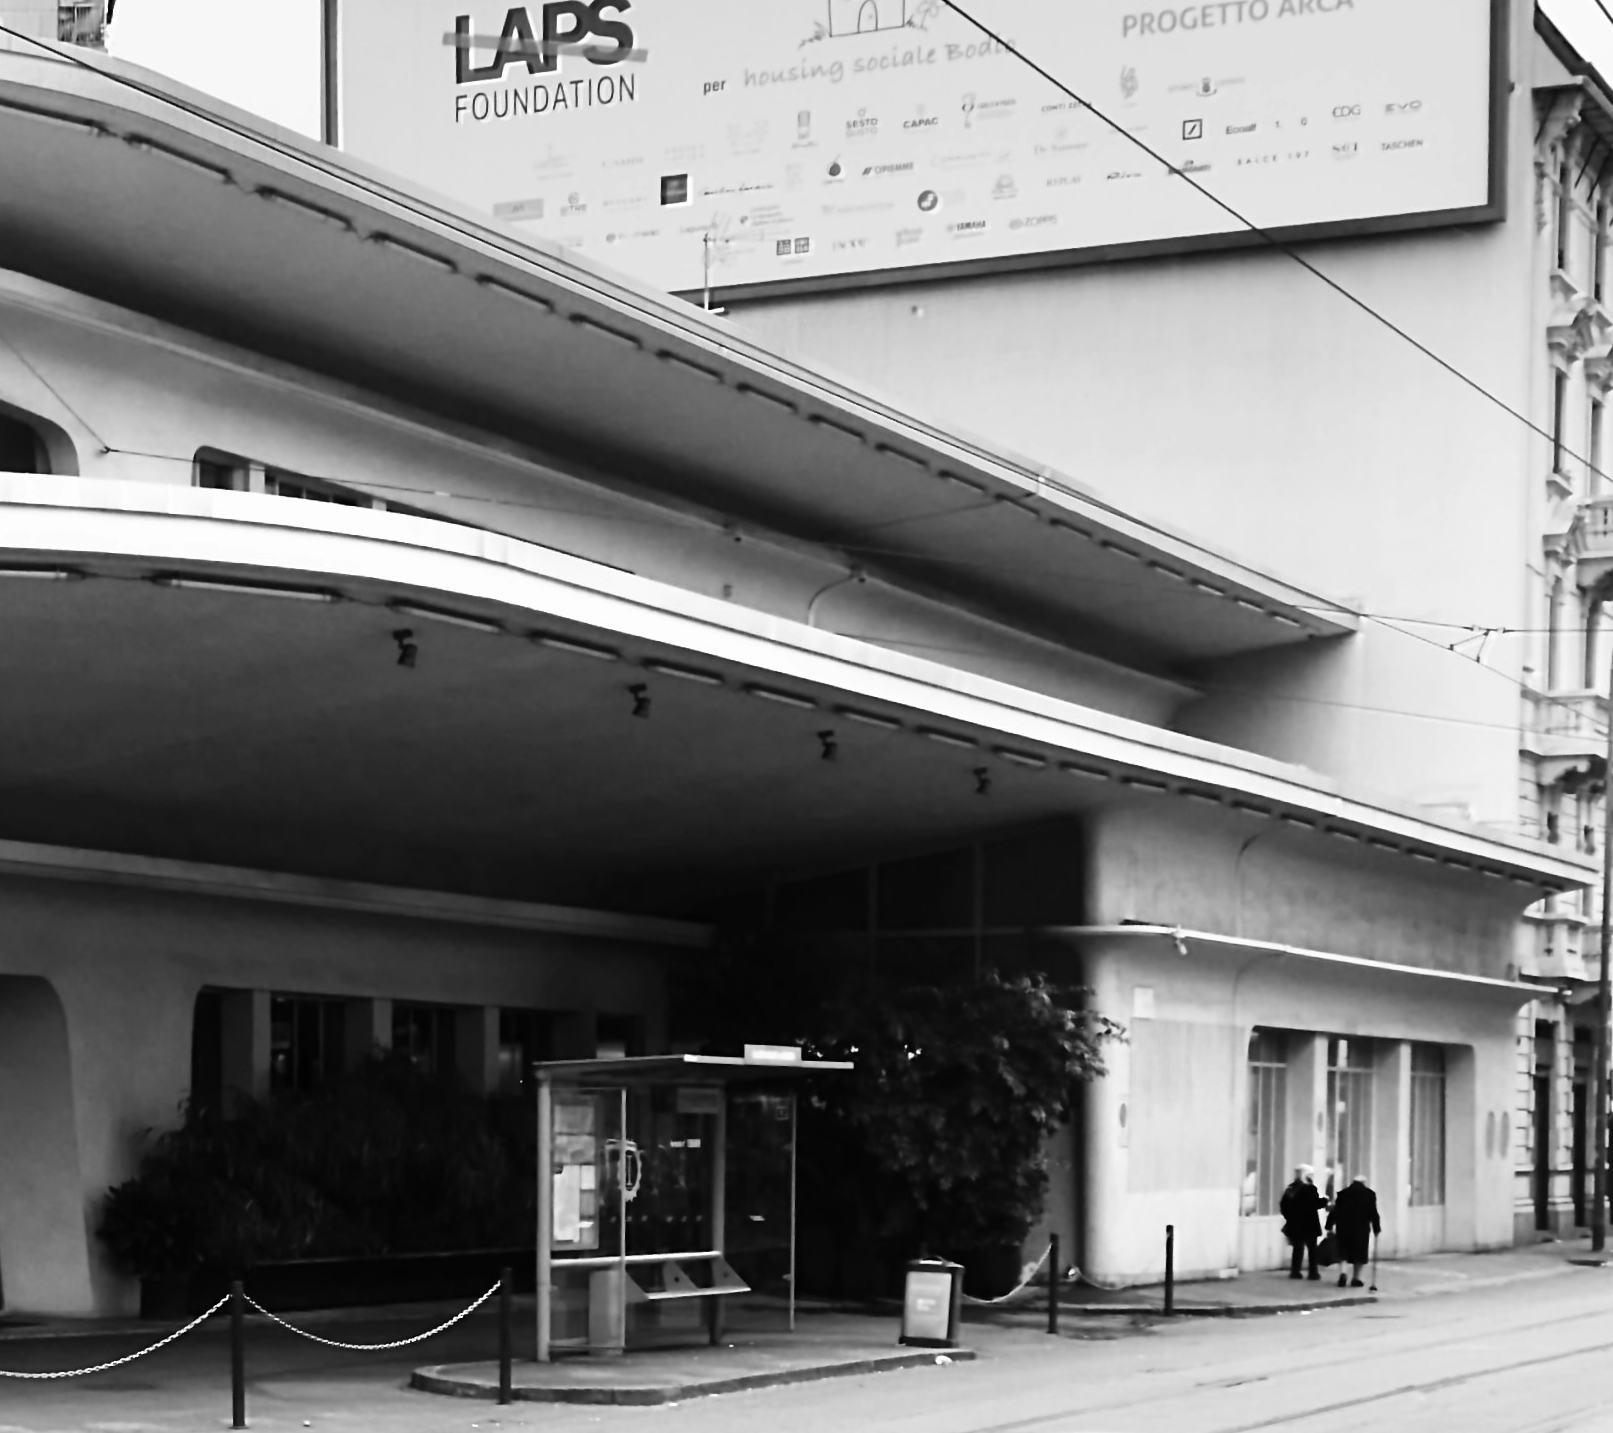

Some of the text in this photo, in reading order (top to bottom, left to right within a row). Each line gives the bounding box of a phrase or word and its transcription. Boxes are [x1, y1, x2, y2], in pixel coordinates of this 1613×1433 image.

[743, 57, 844, 87] housing
[853, 44, 937, 74] sociale
[456, 74, 634, 123] FOUNDATION
[702, 76, 727, 95] per
[956, 220, 986, 231] YAMAHA
